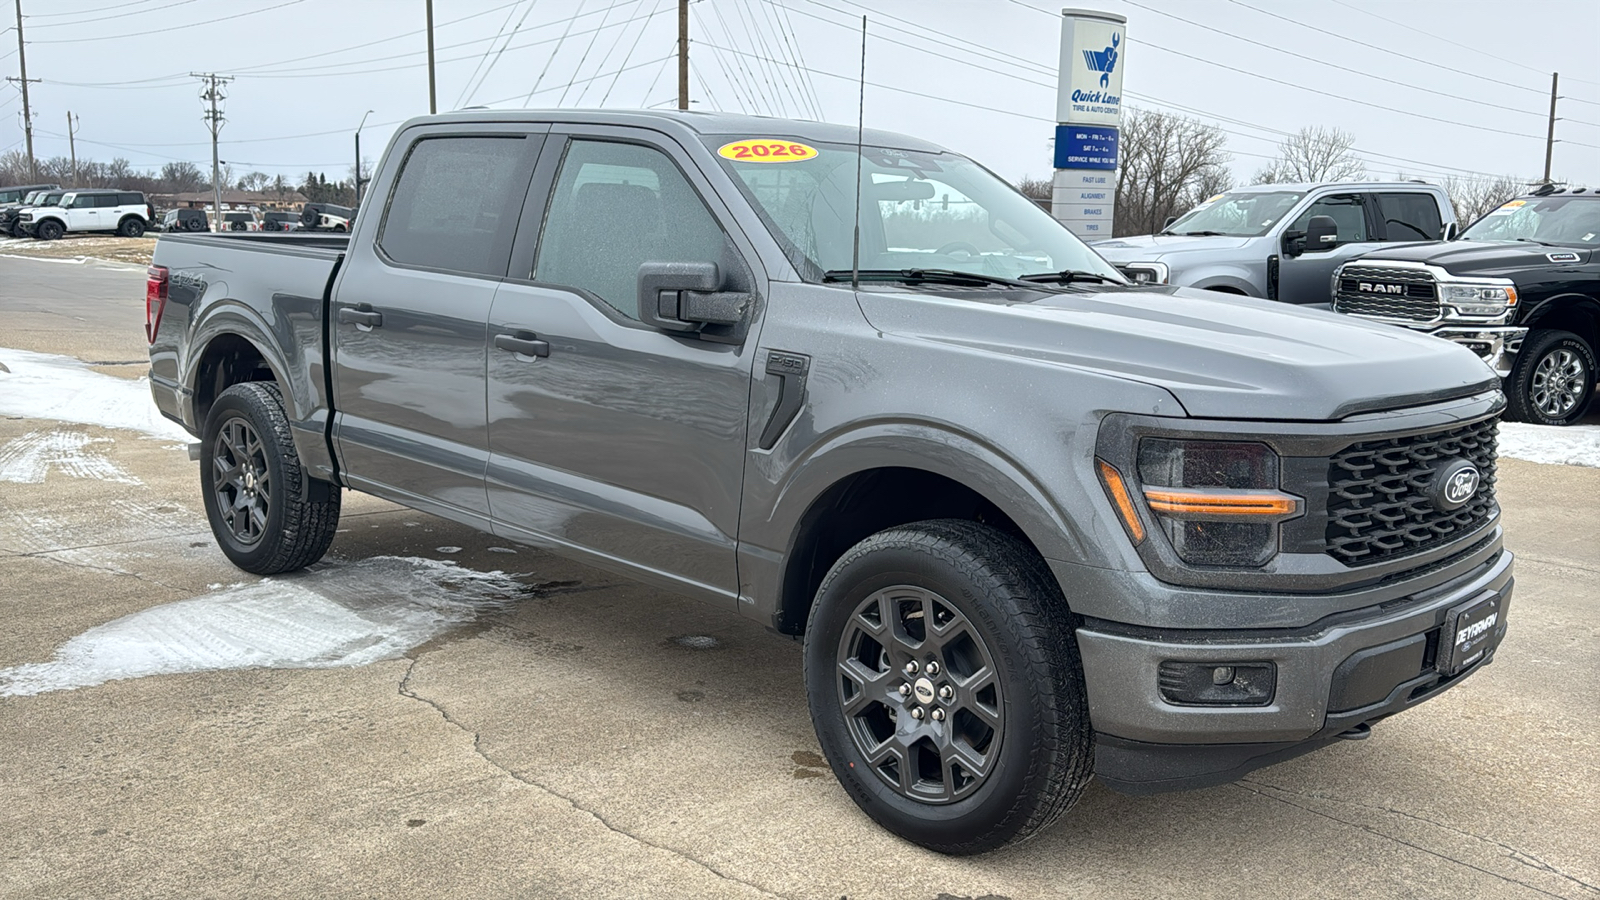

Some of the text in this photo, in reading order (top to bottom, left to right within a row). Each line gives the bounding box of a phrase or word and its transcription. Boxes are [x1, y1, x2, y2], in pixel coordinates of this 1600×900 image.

[1071, 89, 1120, 105] Quick Lane
[1072, 104, 1085, 112] TIRE
[732, 144, 807, 158] 2026
[1359, 282, 1402, 294] RAM
[1451, 472, 1475, 498] Ford
